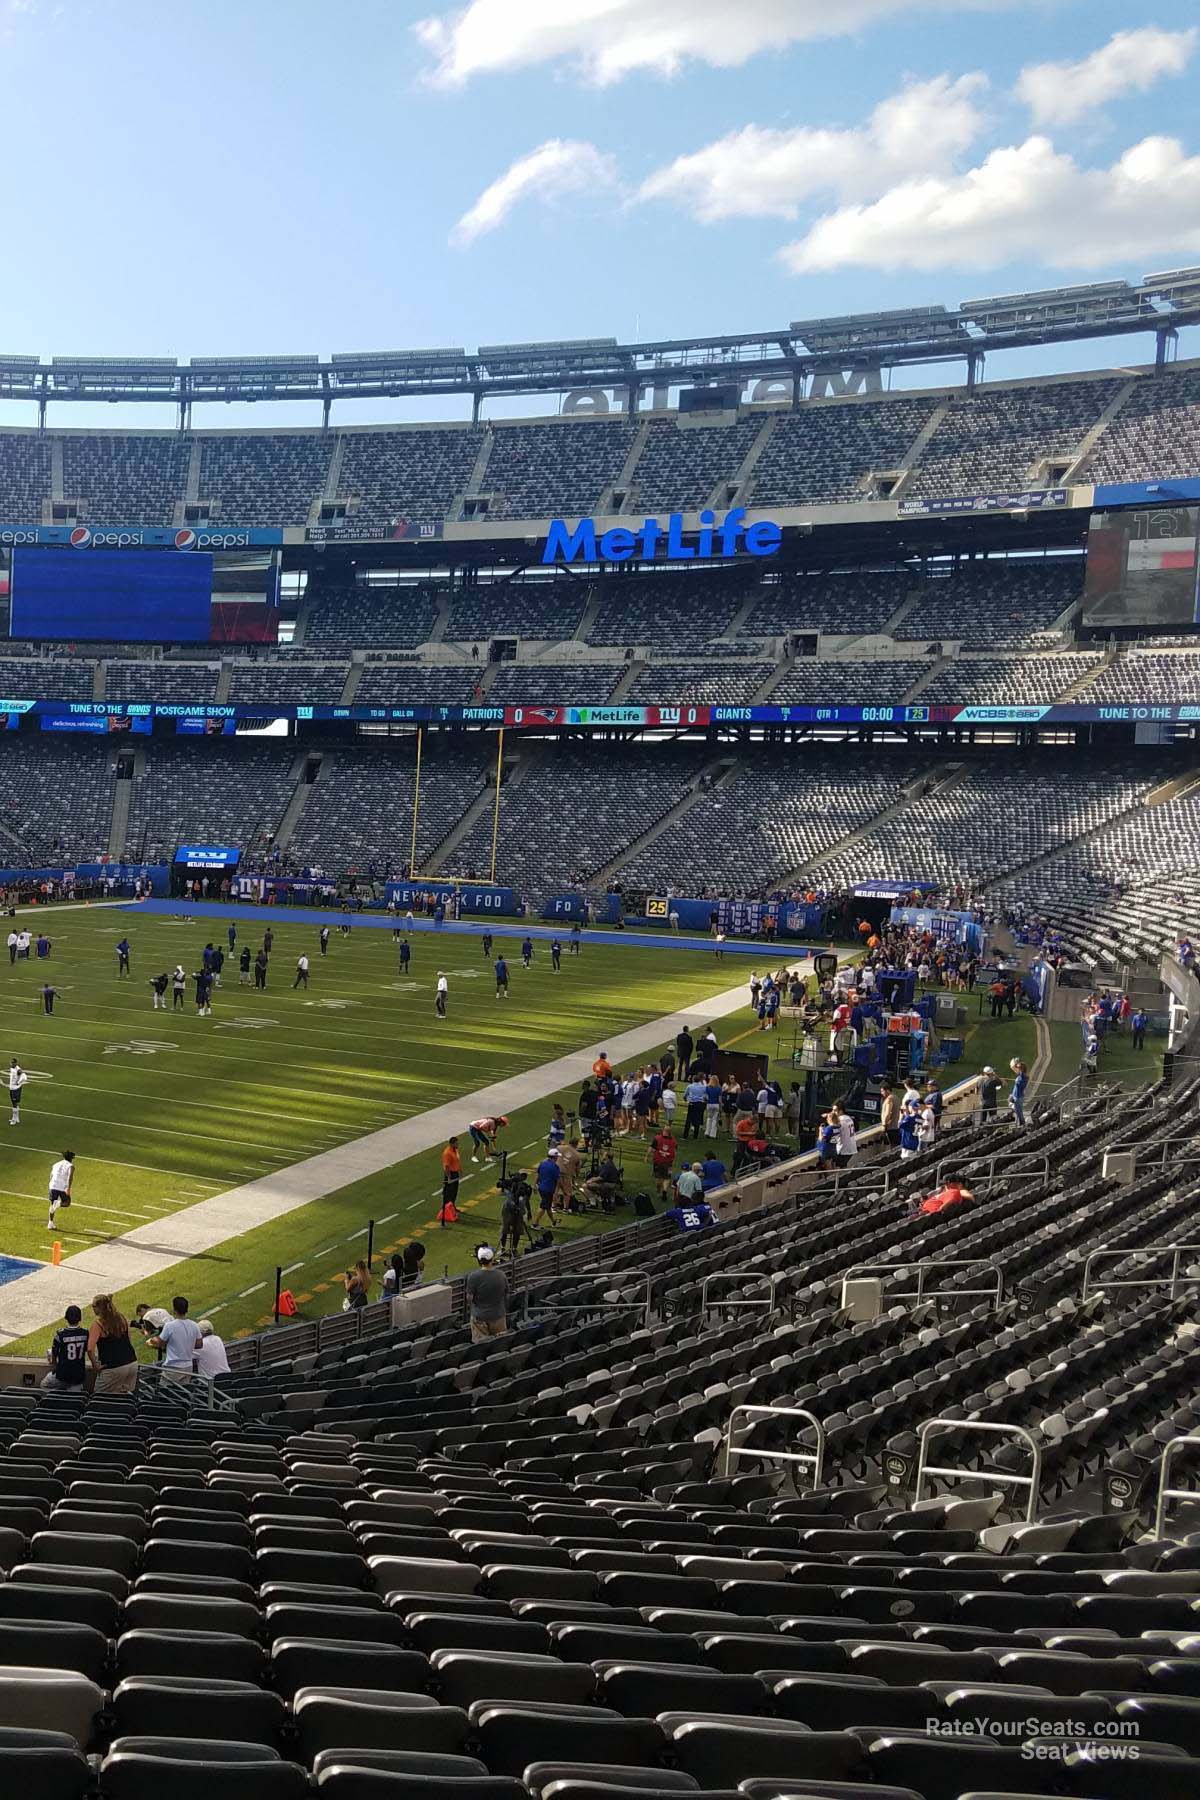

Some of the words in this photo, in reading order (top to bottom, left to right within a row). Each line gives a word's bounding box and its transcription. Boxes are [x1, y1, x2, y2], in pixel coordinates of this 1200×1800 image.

[91, 530, 143, 547] pepsi
[197, 531, 249, 549] pepsi
[542, 507, 782, 563] MetLife
[70, 704, 92, 713] TUNE
[93, 705, 105, 713] TO
[107, 705, 122, 714] THE
[155, 707, 205, 716] POSTGAME
[206, 707, 235, 716] SHOW
[463, 708, 504, 719] PATRIOTS
[514, 708, 523, 723] 0
[591, 709, 640, 722] MetLife
[688, 709, 696, 723] 0
[716, 707, 751, 719] GIANTS
[862, 707, 893, 721] 60:00
[912, 709, 924, 720] 25
[965, 709, 1007, 719] WCBS
[1099, 708, 1129, 719] TUNE
[1132, 708, 1148, 719] TO
[1151, 708, 1171, 719] THE
[650, 901, 665, 914] 25
[683, 1212, 700, 1227] 26
[66, 1343, 85, 1360] 87
